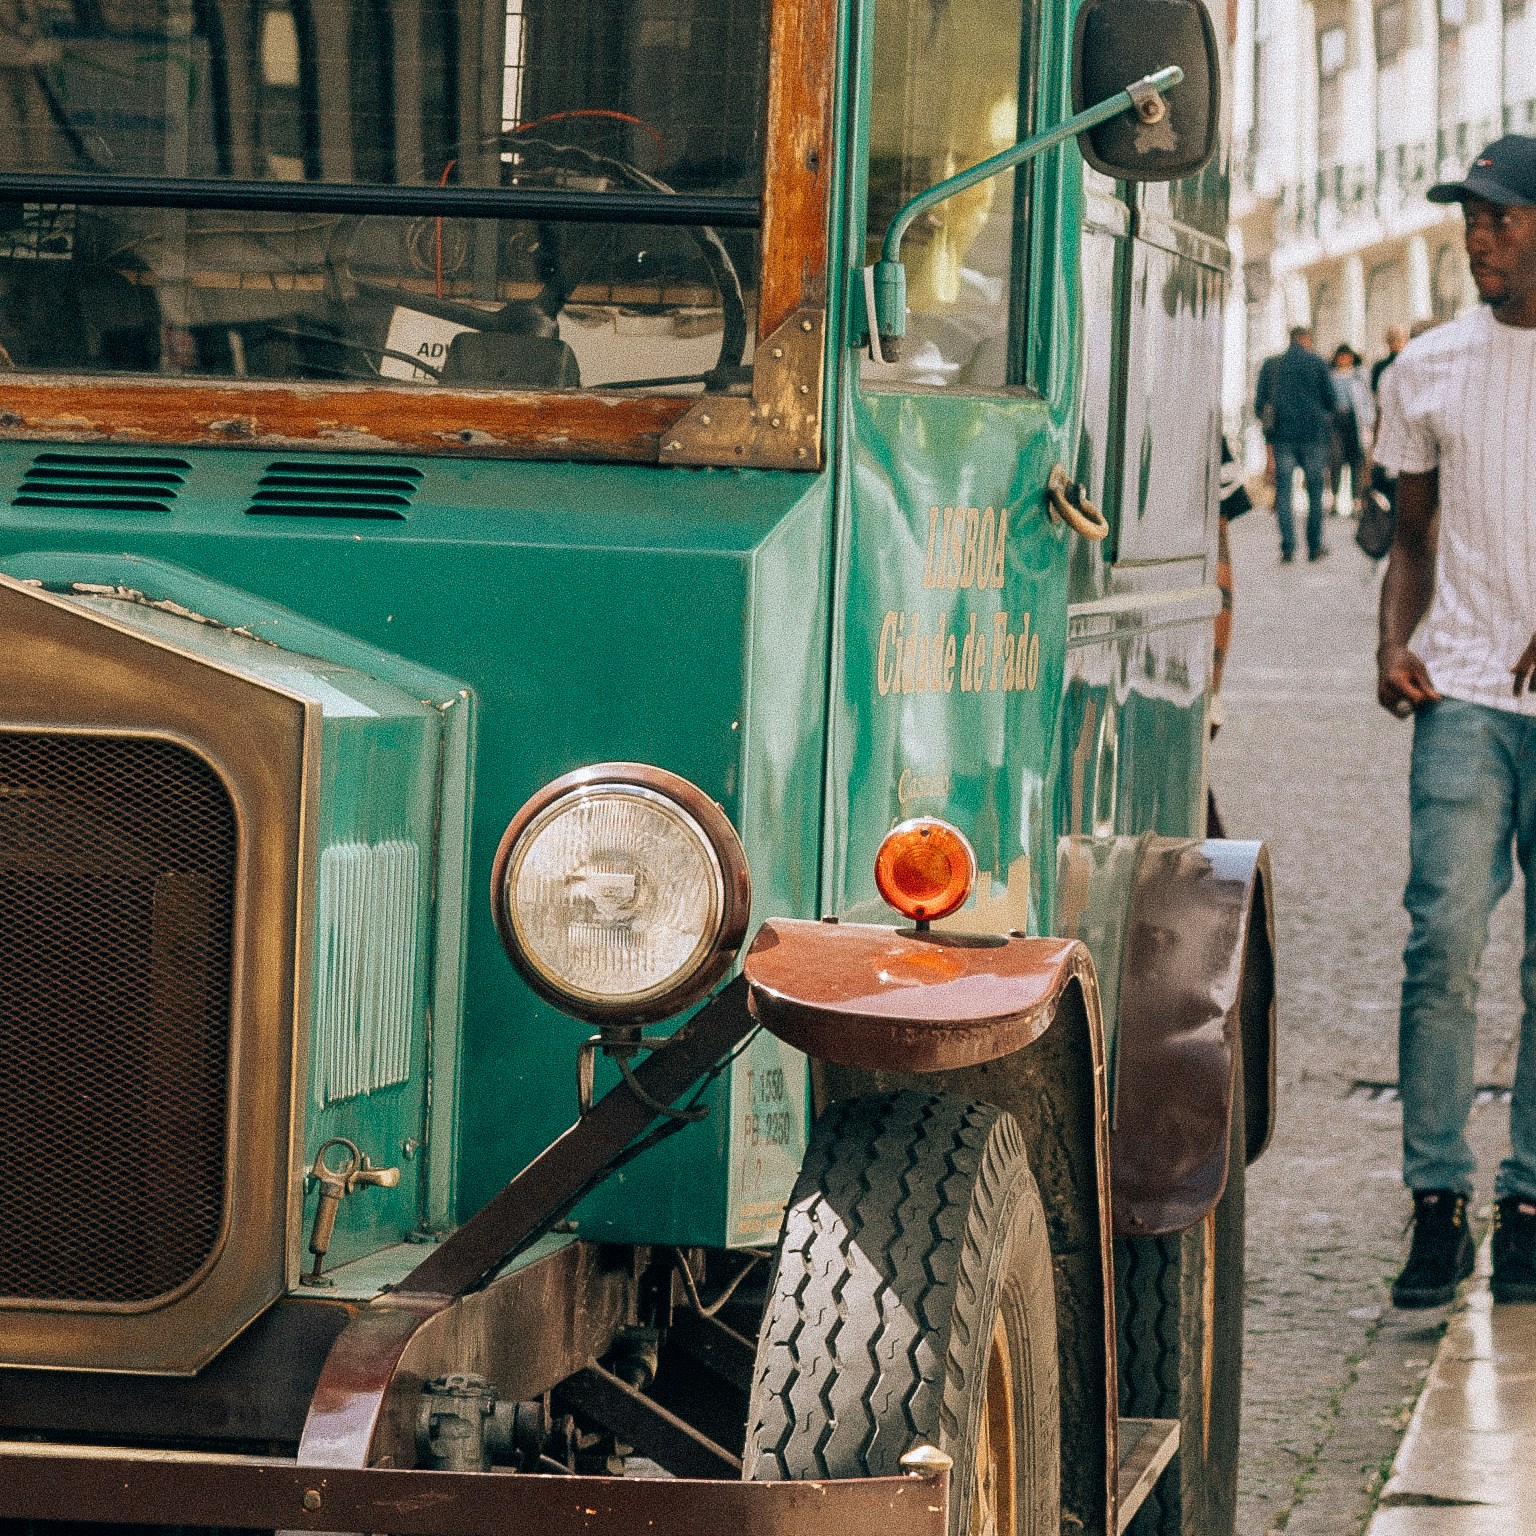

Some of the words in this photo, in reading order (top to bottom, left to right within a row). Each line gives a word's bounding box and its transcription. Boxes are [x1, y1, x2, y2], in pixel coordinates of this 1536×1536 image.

[923, 506, 1007, 591] LISBOA
[877, 610, 957, 696] Cidade
[960, 612, 986, 693] de
[988, 612, 1040, 693] Fado
